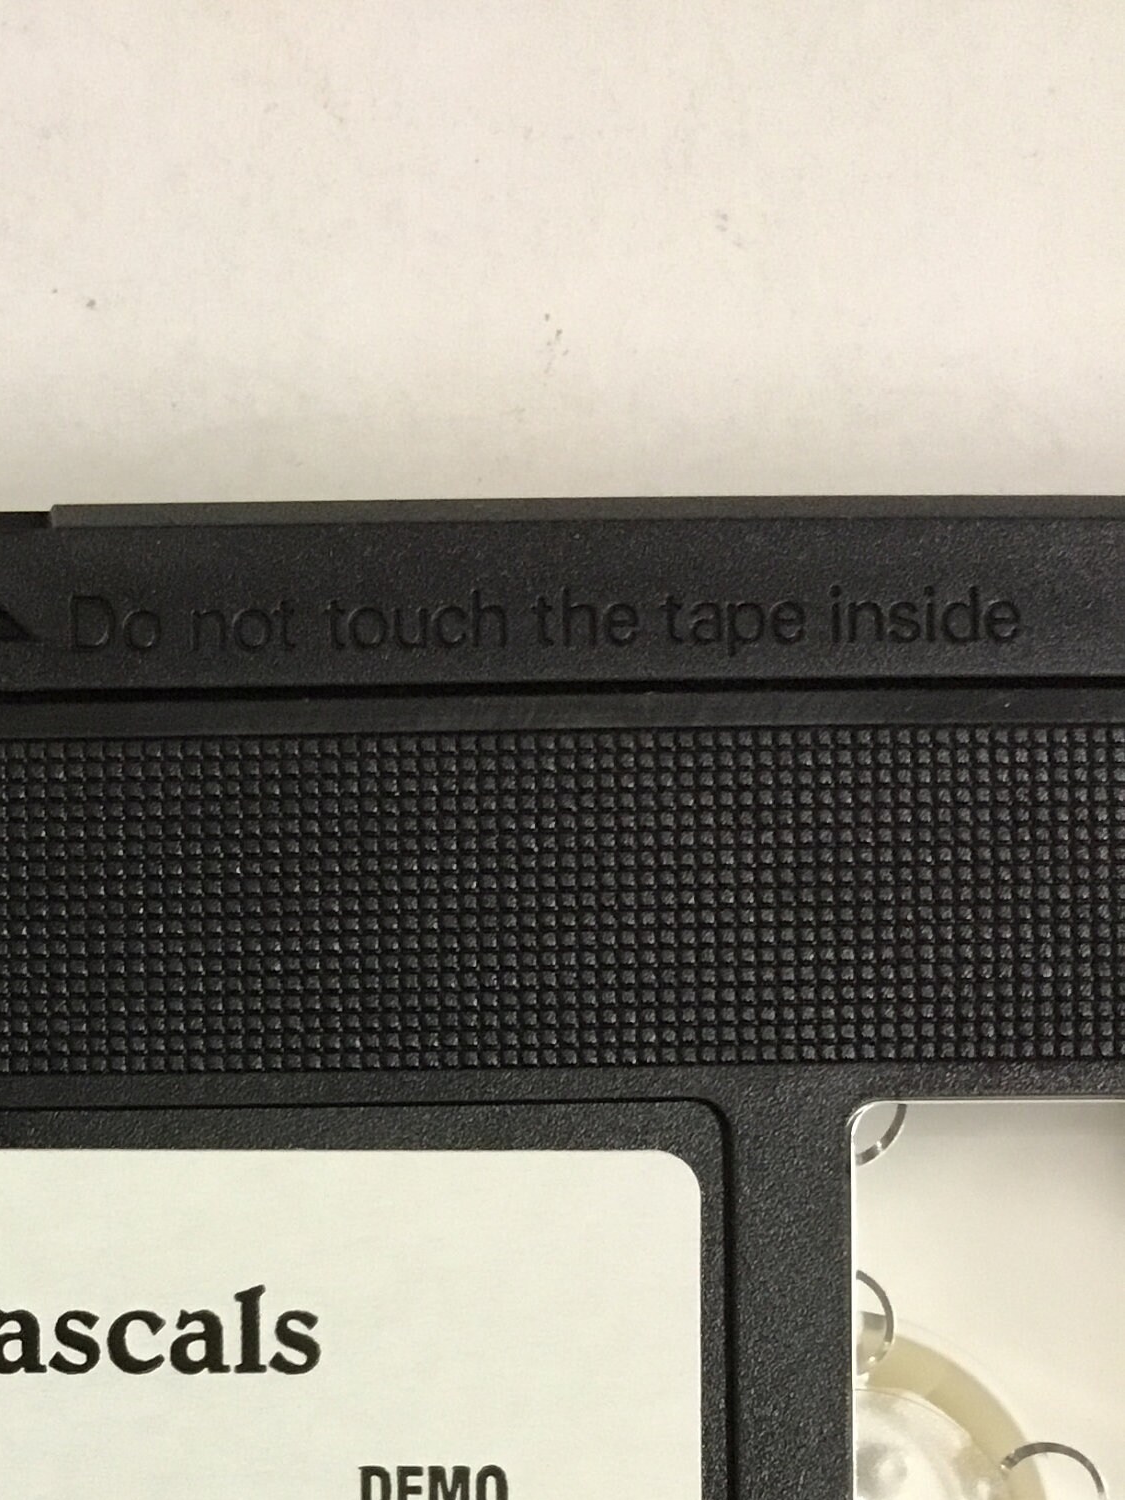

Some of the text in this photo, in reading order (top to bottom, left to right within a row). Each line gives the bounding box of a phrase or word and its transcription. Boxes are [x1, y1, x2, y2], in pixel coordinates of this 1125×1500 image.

[70, 583, 1021, 657] Do not touch the tape inside
